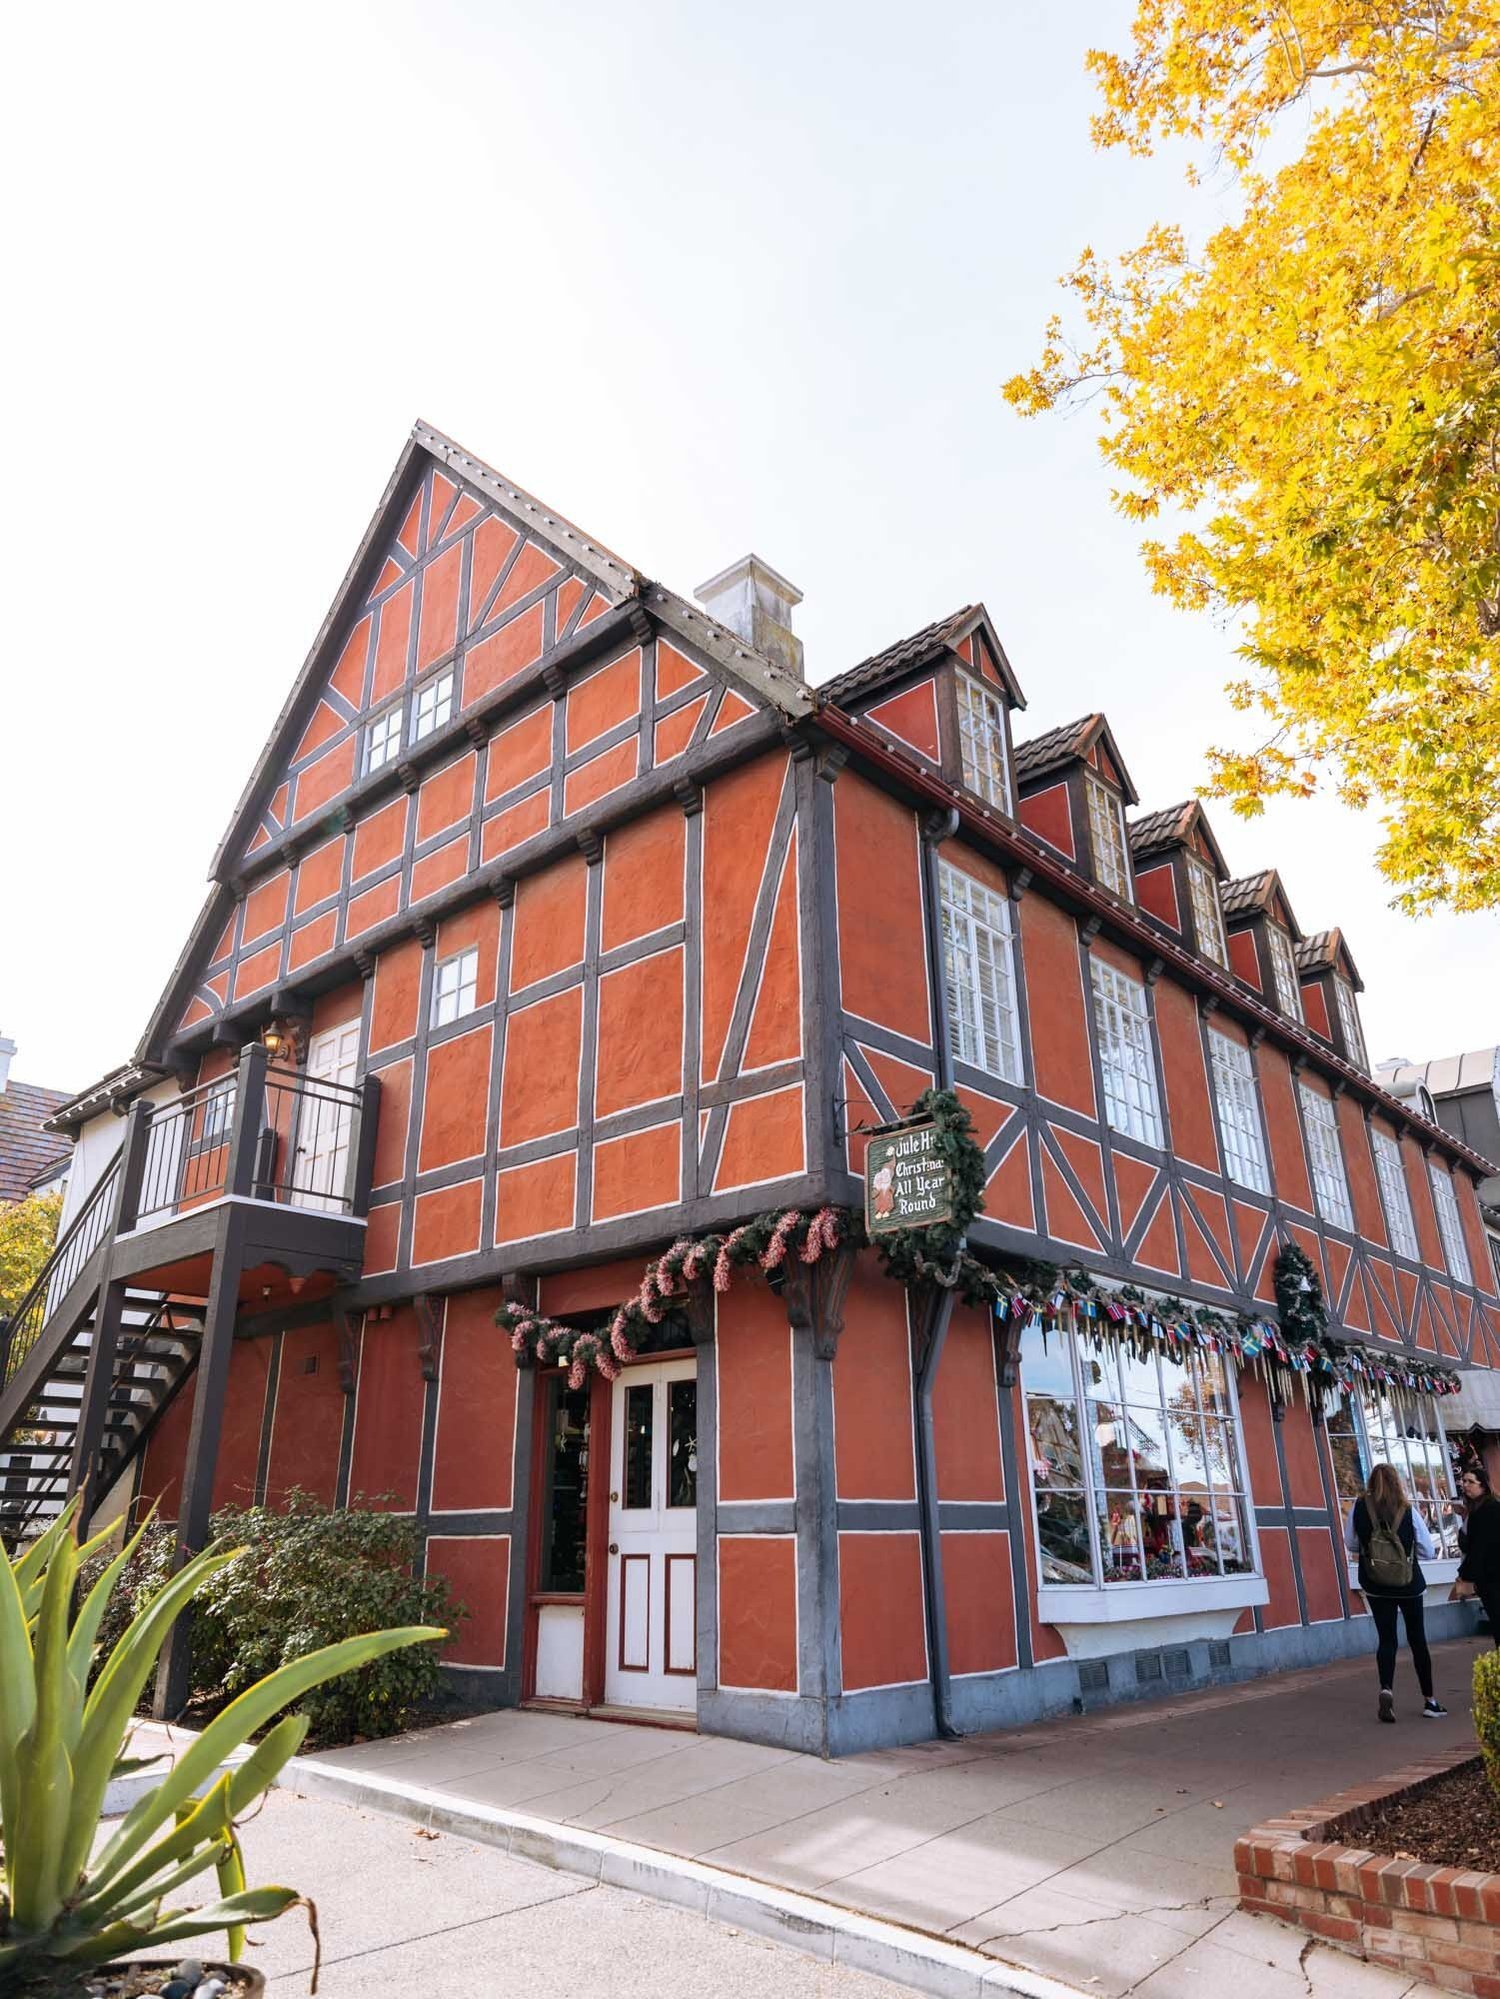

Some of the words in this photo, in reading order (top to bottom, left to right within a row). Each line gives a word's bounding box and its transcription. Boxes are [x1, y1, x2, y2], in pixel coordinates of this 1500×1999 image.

[895, 1180, 911, 1197] All
[916, 1176, 944, 1196] Year
[899, 1192, 936, 1214] Round
